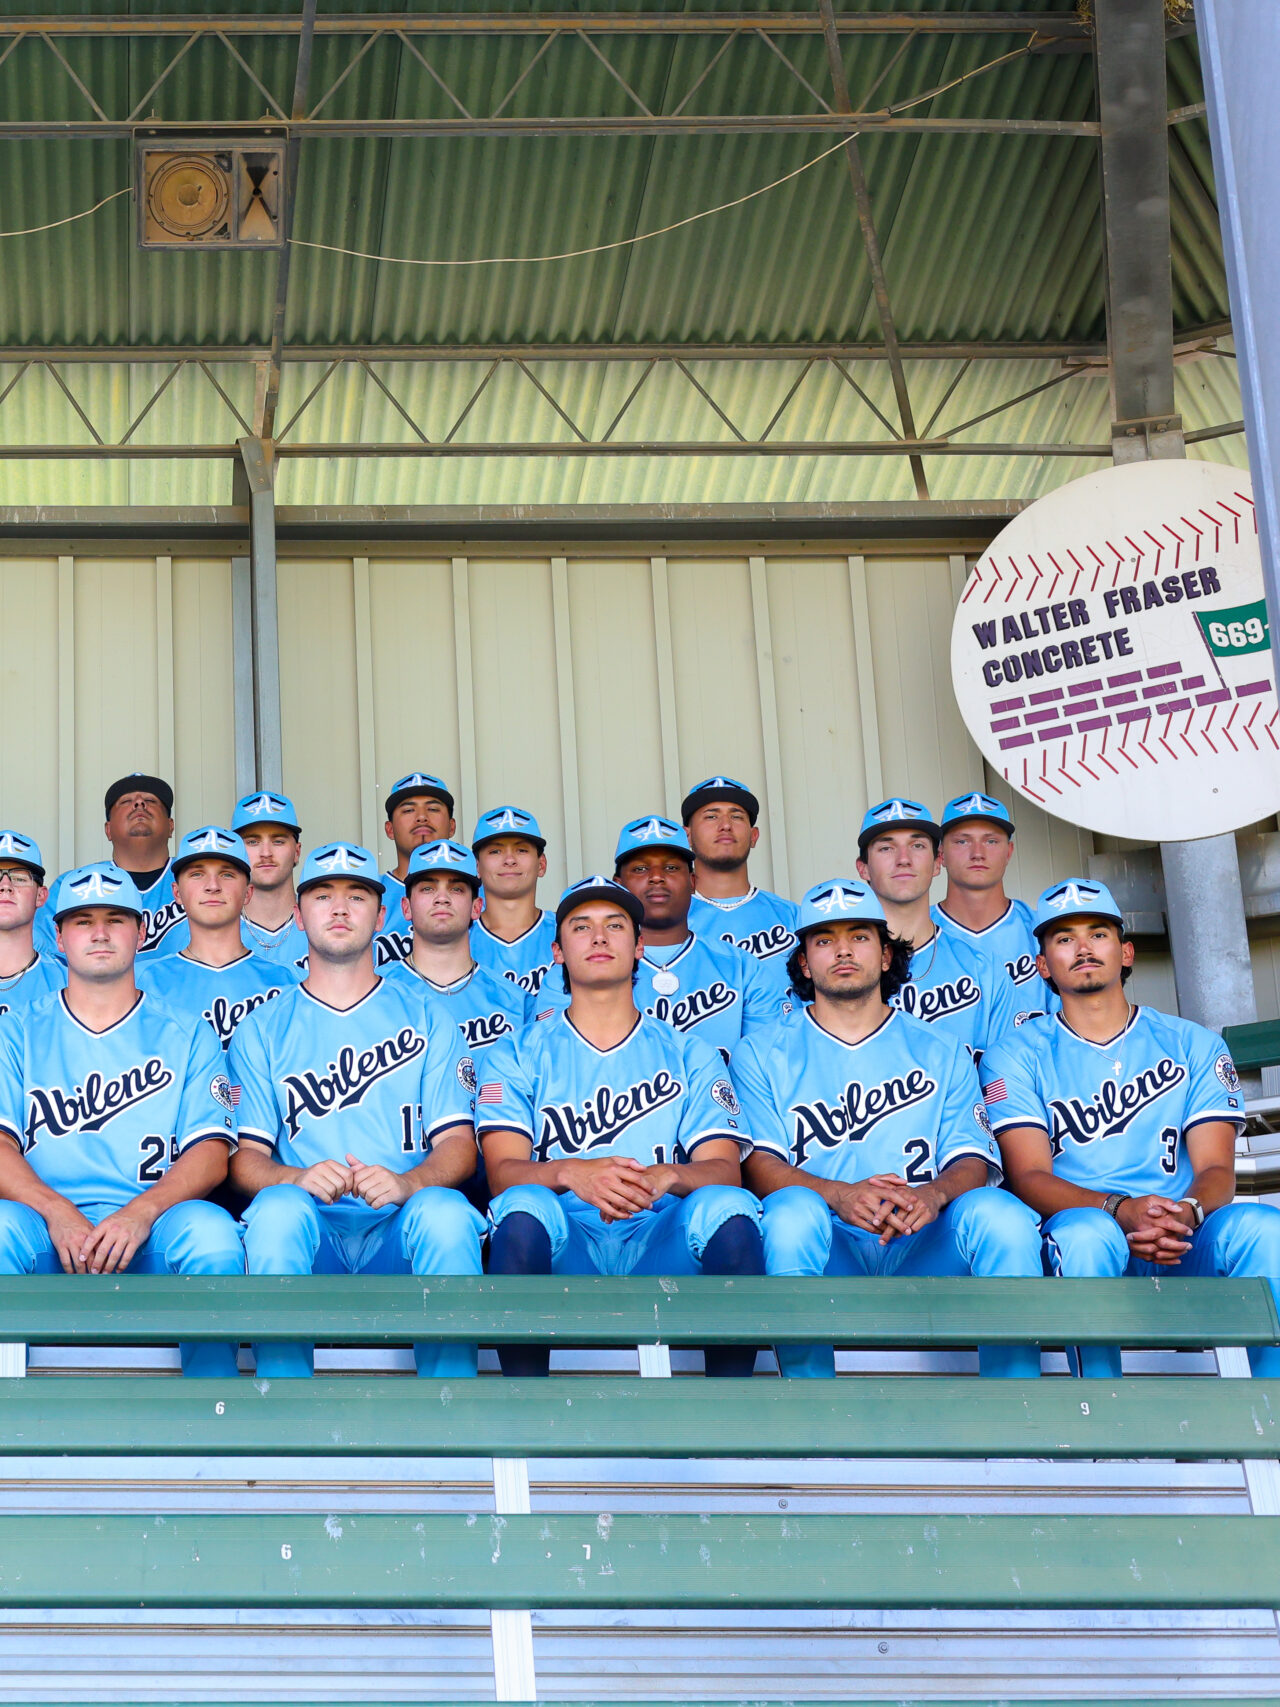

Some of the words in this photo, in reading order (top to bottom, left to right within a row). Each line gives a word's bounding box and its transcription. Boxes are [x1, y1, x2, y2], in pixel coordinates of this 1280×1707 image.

[972, 598, 1091, 650] WALTER
[1103, 566, 1222, 619] FRASER
[982, 627, 1134, 688] CONCRETE
[23, 1056, 176, 1157] Abilene
[282, 1025, 427, 1140] Abilene
[1046, 1056, 1187, 1161] Abilene
[532, 1068, 685, 1161] Abilene
[788, 1067, 938, 1169] Abilene
[902, 1138, 935, 1183] 2
[1159, 1127, 1180, 1175] 3
[215, 1402, 224, 1414] 6
[1080, 1402, 1090, 1415] 9
[281, 1544, 291, 1559] 6
[582, 1544, 591, 1560] 7
